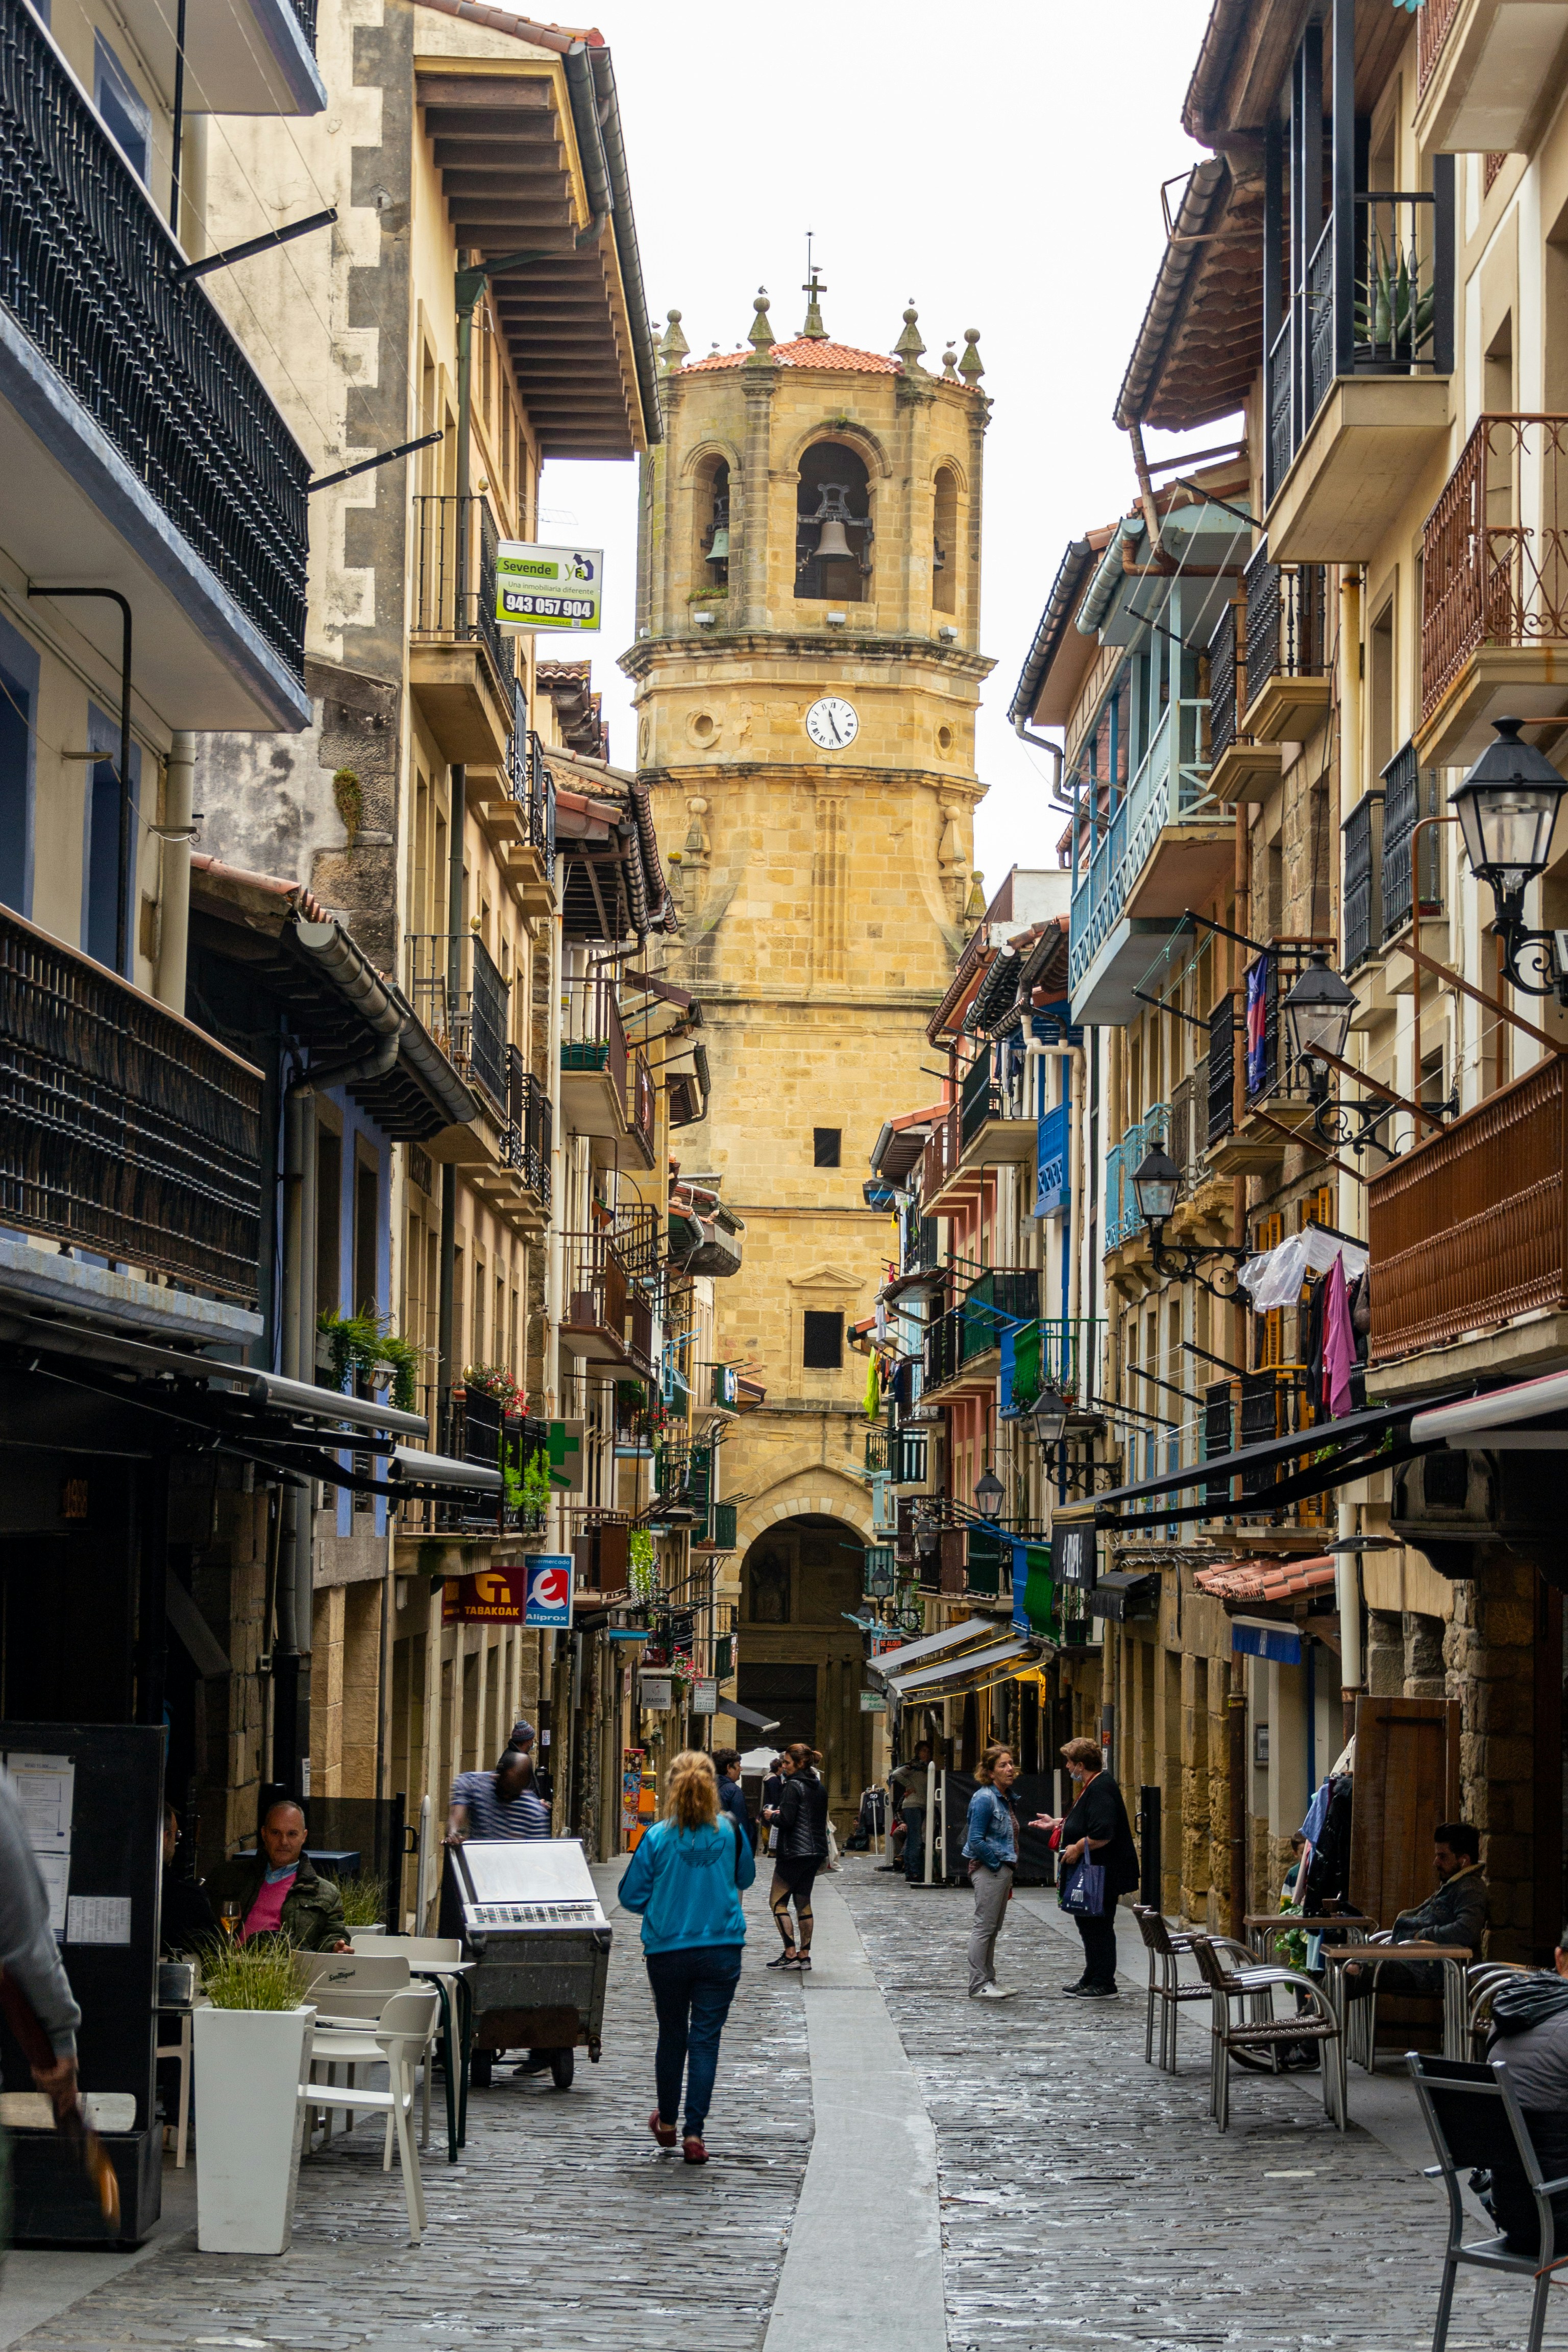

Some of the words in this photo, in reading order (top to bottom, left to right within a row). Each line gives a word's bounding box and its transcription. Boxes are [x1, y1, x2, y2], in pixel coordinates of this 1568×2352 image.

[503, 560, 551, 575] Sevende
[523, 582, 561, 593] inmobiliaria
[563, 586, 594, 595] diferente
[506, 595, 533, 612] 943
[536, 598, 561, 615] 057
[563, 601, 591, 618] 904
[526, 617, 571, 626] www.sevendeya.es
[464, 1606, 520, 1616] TABAKOAK
[526, 1613, 567, 1622] Aliprox
